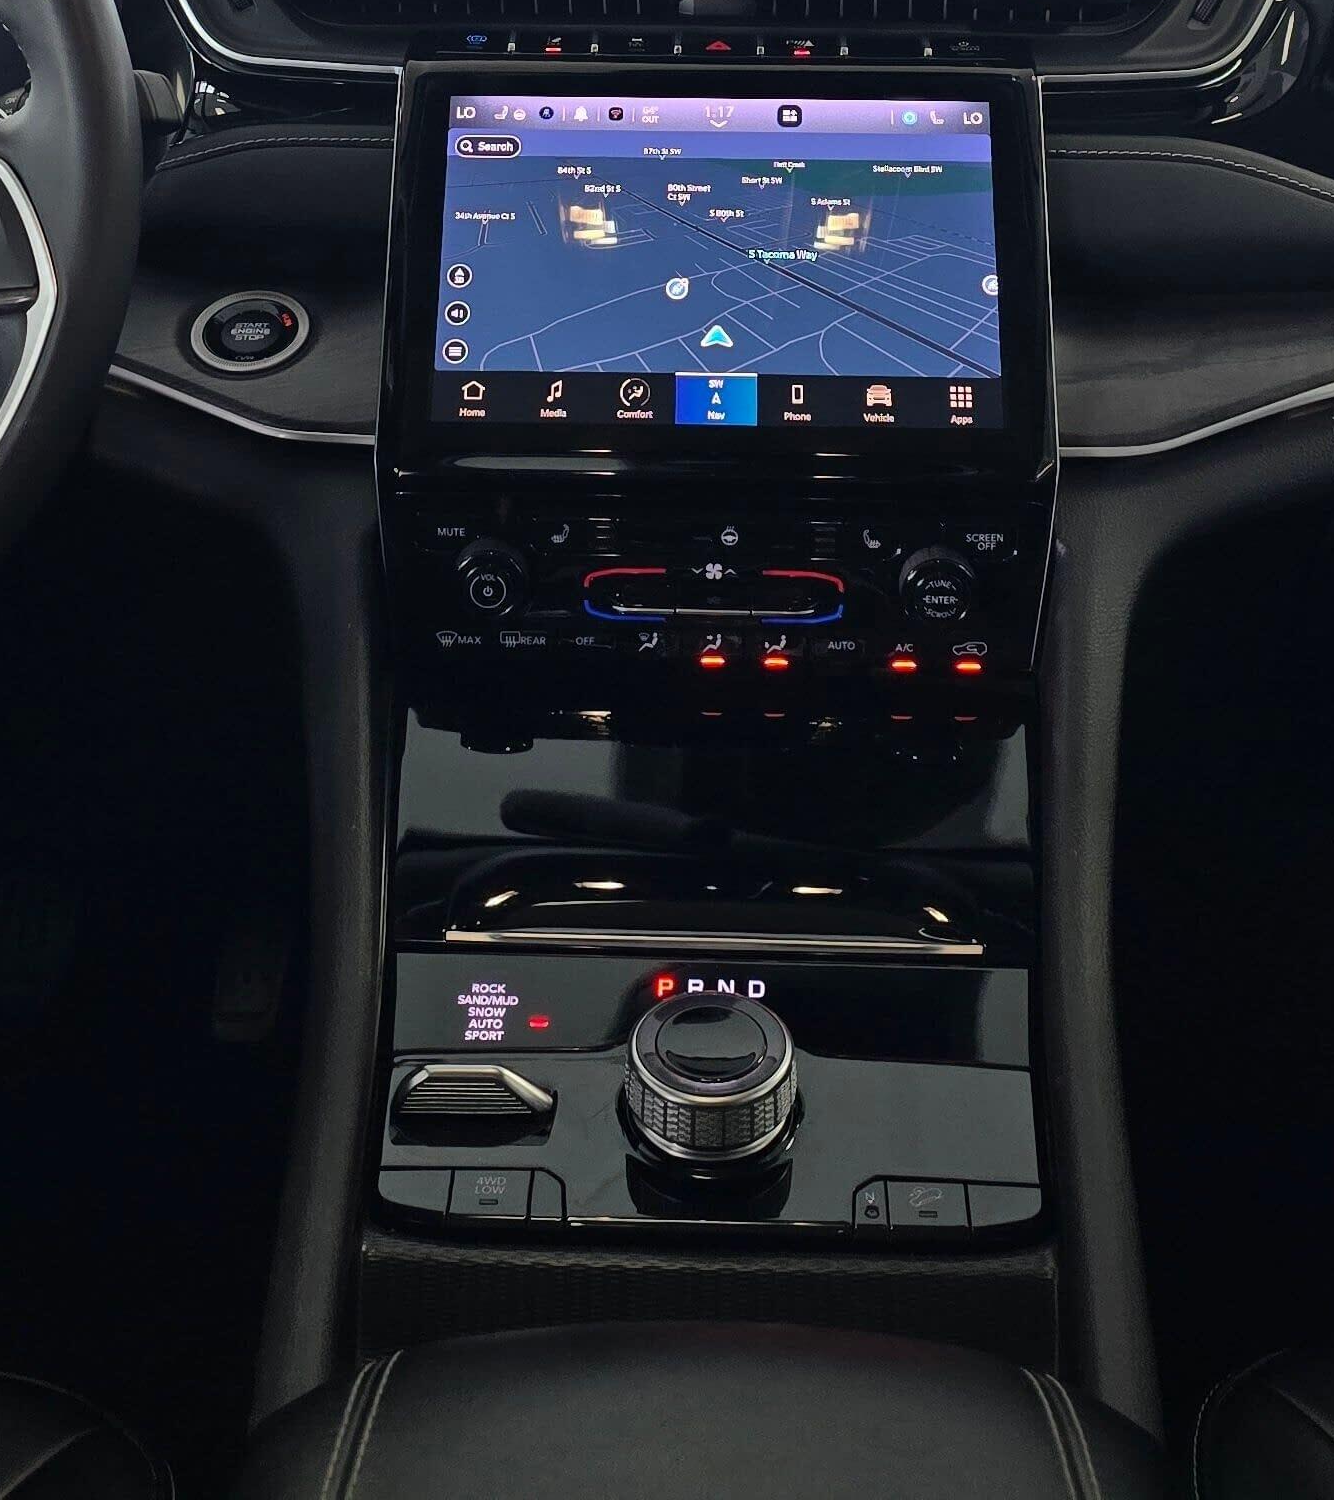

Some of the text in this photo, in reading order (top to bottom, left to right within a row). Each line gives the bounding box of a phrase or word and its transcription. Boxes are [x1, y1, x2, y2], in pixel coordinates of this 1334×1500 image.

[457, 106, 476, 119] LO
[705, 106, 734, 118] 1:17
[642, 115, 659, 124] OUT
[963, 112, 983, 125] LO
[478, 141, 514, 152] Search
[577, 166, 585, 174] St
[586, 166, 592, 174] S
[771, 176, 783, 184] SW
[687, 184, 711, 192] Street
[678, 193, 691, 201] SW
[842, 198, 851, 206] St
[735, 210, 745, 218] St
[749, 250, 818, 261] S Tacoma Way
[708, 380, 724, 389] SW
[459, 408, 486, 418] Home
[540, 408, 567, 418] Media
[617, 409, 653, 419] Comfort
[707, 411, 726, 421] Nav
[784, 412, 812, 422] Phone
[863, 413, 895, 423] Vehicle
[950, 415, 973, 426] Apps
[437, 527, 466, 537] MUTE
[966, 533, 1004, 542] SCREEN
[977, 542, 997, 551] OFF
[481, 573, 496, 582] VOL
[929, 580, 952, 589] TUNE
[925, 595, 956, 605] ENTER
[925, 607, 957, 619] SCROLL
[458, 636, 482, 645] MAX
[520, 636, 546, 645] REAR
[575, 636, 595, 646] OFF
[827, 641, 856, 651] AUTO
[895, 643, 914, 653] A/C
[471, 983, 507, 994] ROCK
[658, 978, 766, 999] P R N D
[457, 995, 519, 1006] SAND/MUD
[468, 1007, 507, 1018] SNOW
[468, 1019, 503, 1029] AUTO
[464, 1031, 505, 1041] SPORT
[477, 1176, 507, 1185] 4WD
[475, 1185, 506, 1195] LOW
